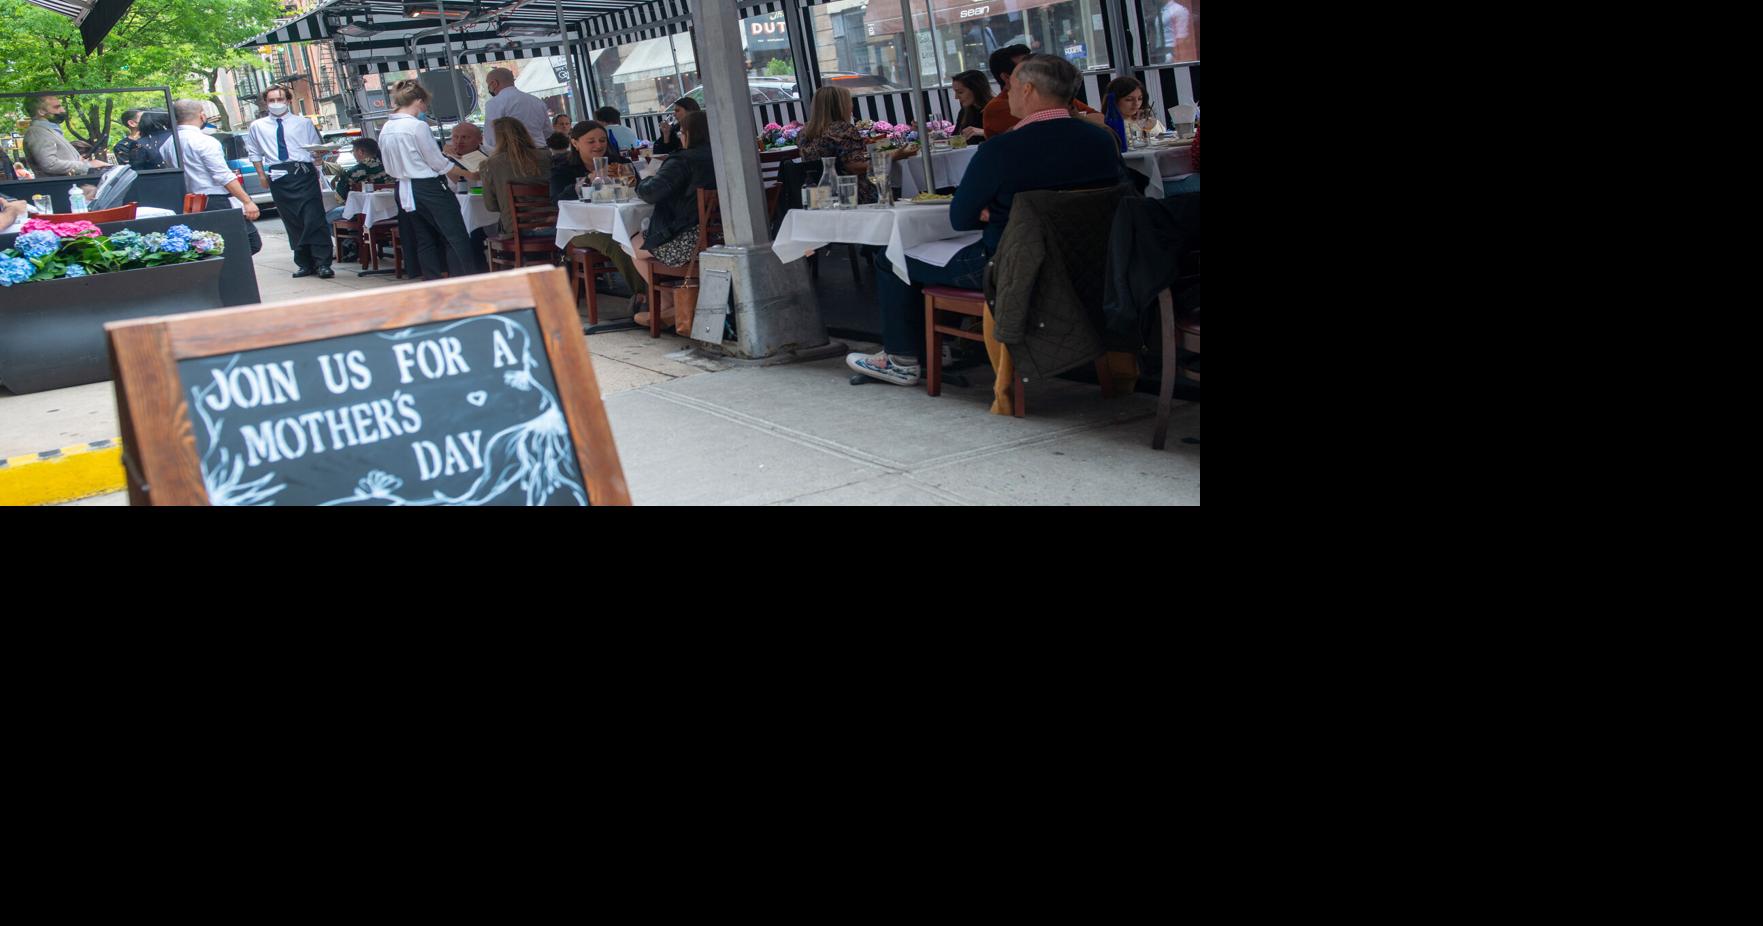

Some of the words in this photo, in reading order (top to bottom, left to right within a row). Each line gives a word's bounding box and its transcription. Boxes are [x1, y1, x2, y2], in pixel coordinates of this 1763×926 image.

[960, 5, 990, 18] sean
[205, 360, 300, 411] JOIN
[317, 350, 372, 395] US
[392, 336, 471, 384] FOR
[493, 329, 518, 368] A
[239, 390, 422, 467] MOTHER'S
[411, 429, 484, 482] DAY
